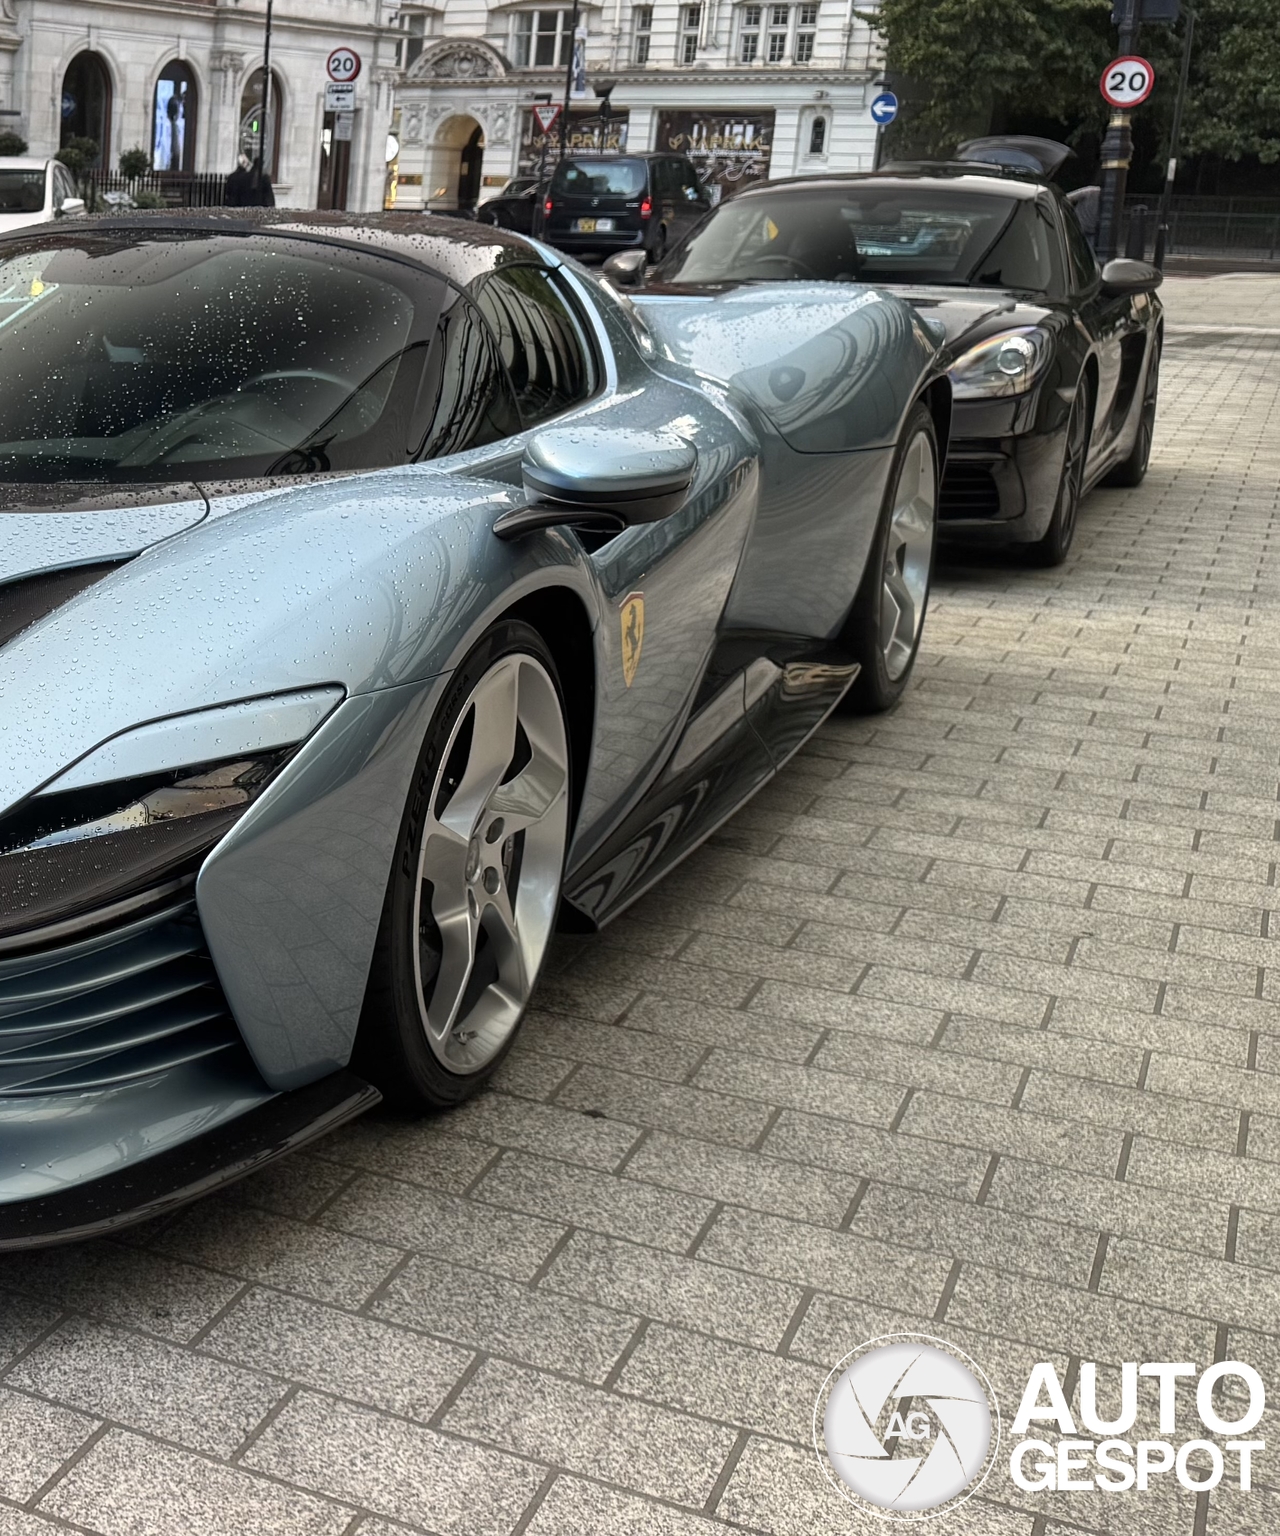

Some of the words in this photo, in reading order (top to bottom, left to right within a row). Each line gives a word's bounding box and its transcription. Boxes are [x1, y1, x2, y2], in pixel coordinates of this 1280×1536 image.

[331, 57, 354, 72] 20
[1109, 71, 1146, 92] 20
[548, 132, 620, 149] YPRK
[687, 134, 763, 150] YAPRAK
